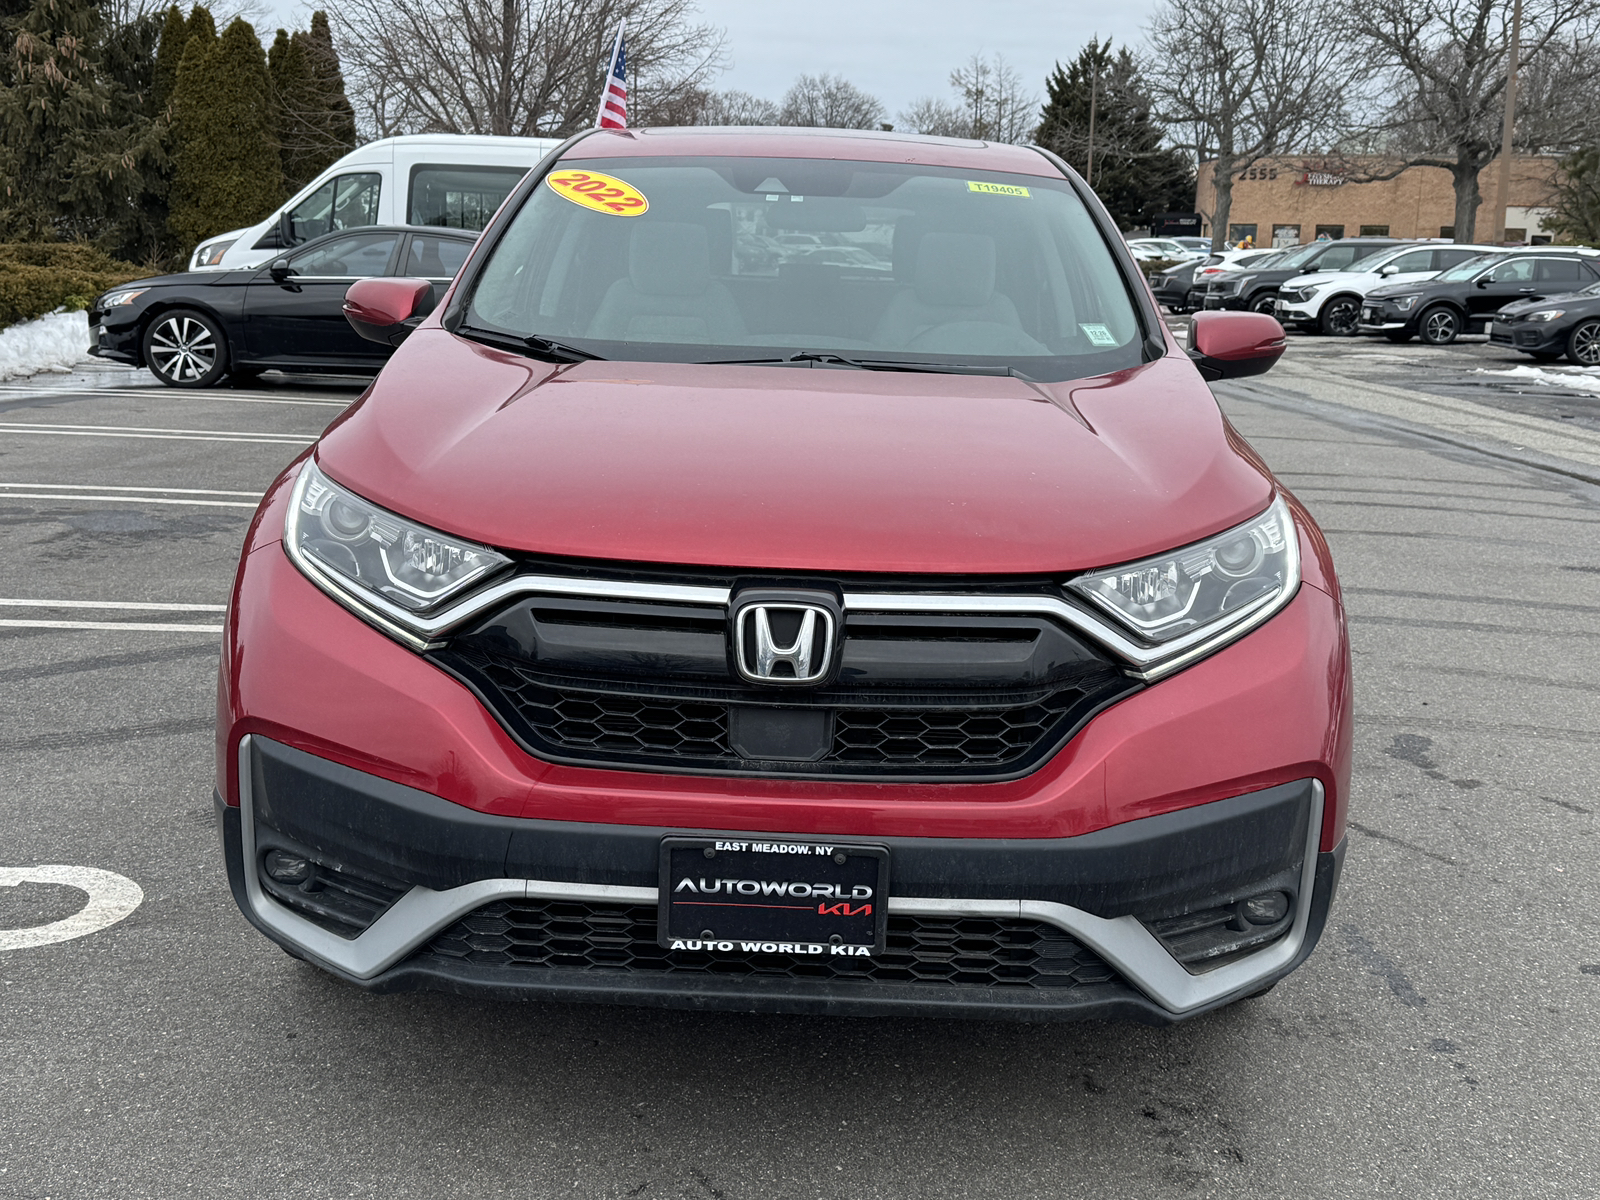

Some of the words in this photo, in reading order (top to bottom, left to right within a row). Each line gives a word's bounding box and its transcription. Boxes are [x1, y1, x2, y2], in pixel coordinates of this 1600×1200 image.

[1238, 167, 1277, 180] 2555
[551, 173, 644, 212] 2022
[974, 183, 1022, 195] T19405
[715, 841, 748, 852] EAST
[815, 846, 834, 856] NY
[673, 877, 873, 900] AUTOWORLD
[818, 902, 872, 916] KIA
[670, 940, 734, 952] AUTO
[740, 942, 823, 955] WORLD
[830, 945, 871, 956] KIA
